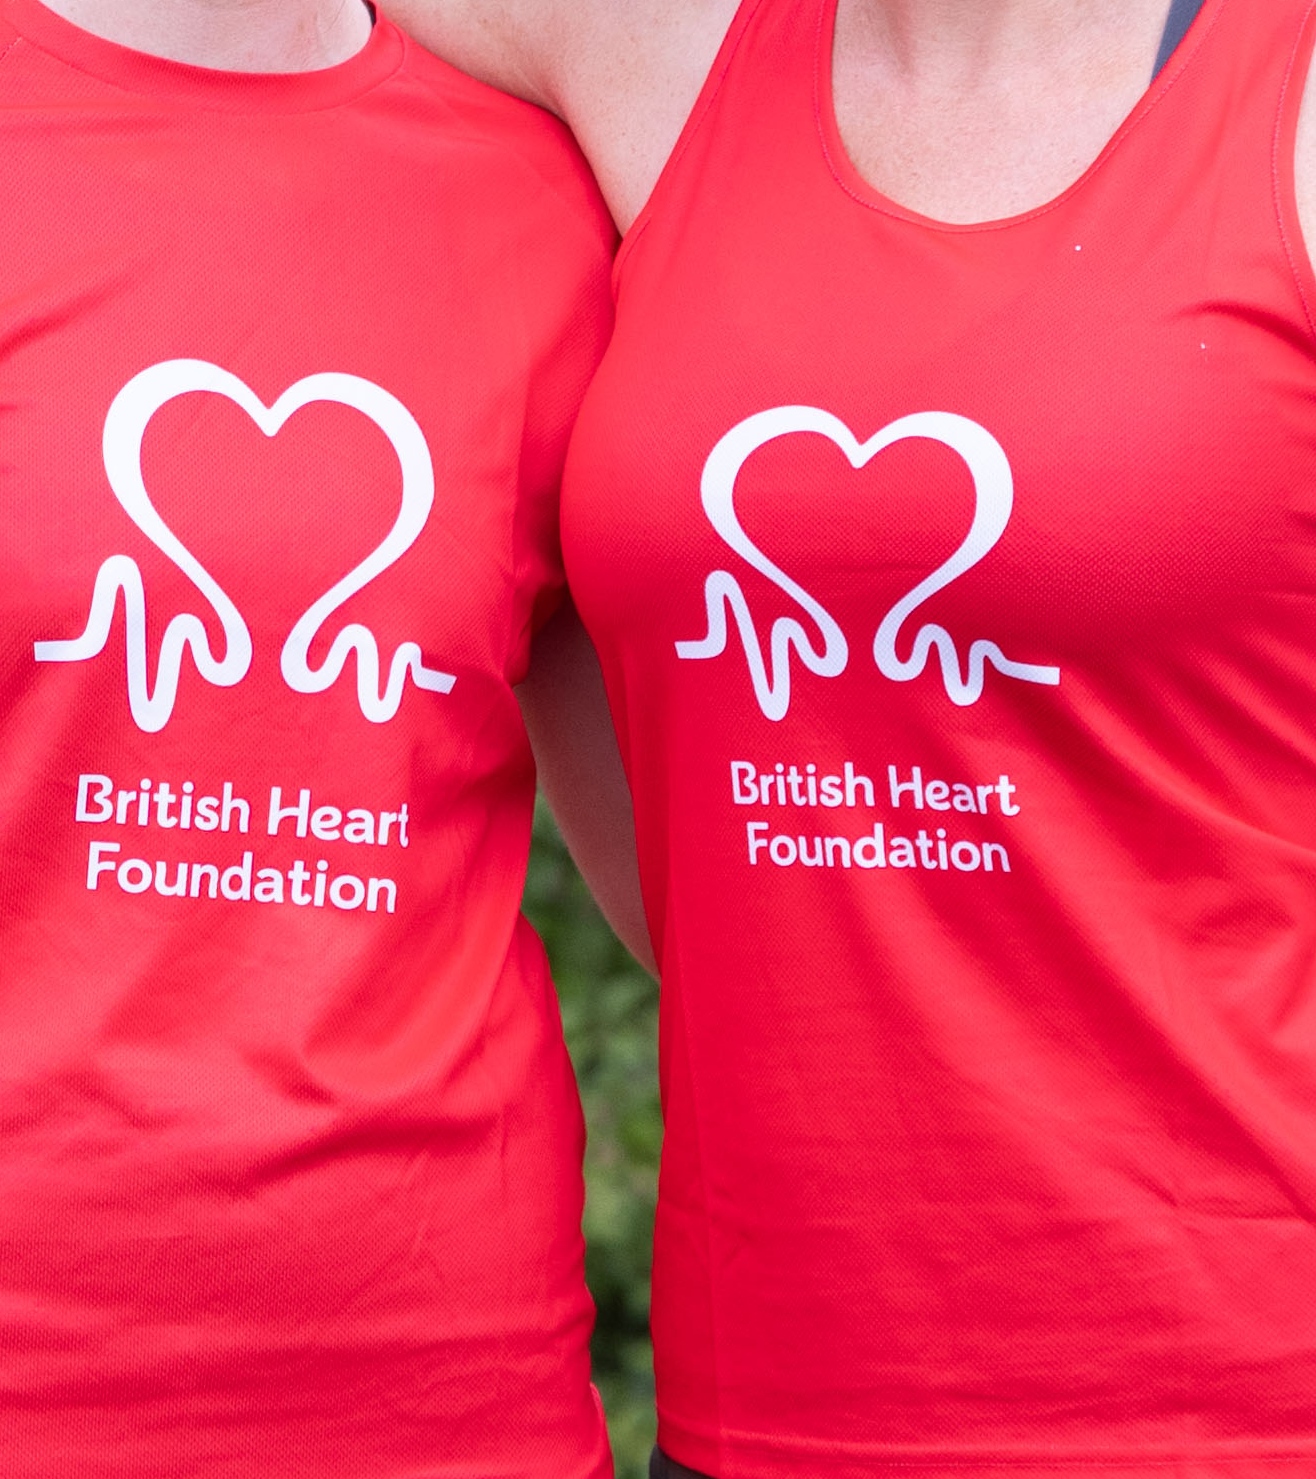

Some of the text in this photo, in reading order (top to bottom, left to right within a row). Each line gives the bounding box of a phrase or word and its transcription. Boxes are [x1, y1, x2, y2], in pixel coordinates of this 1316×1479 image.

[75, 773, 409, 848] British Heart
[730, 760, 1021, 817] British Heart
[86, 840, 398, 914] Foundation
[746, 821, 1012, 873] Foundation
